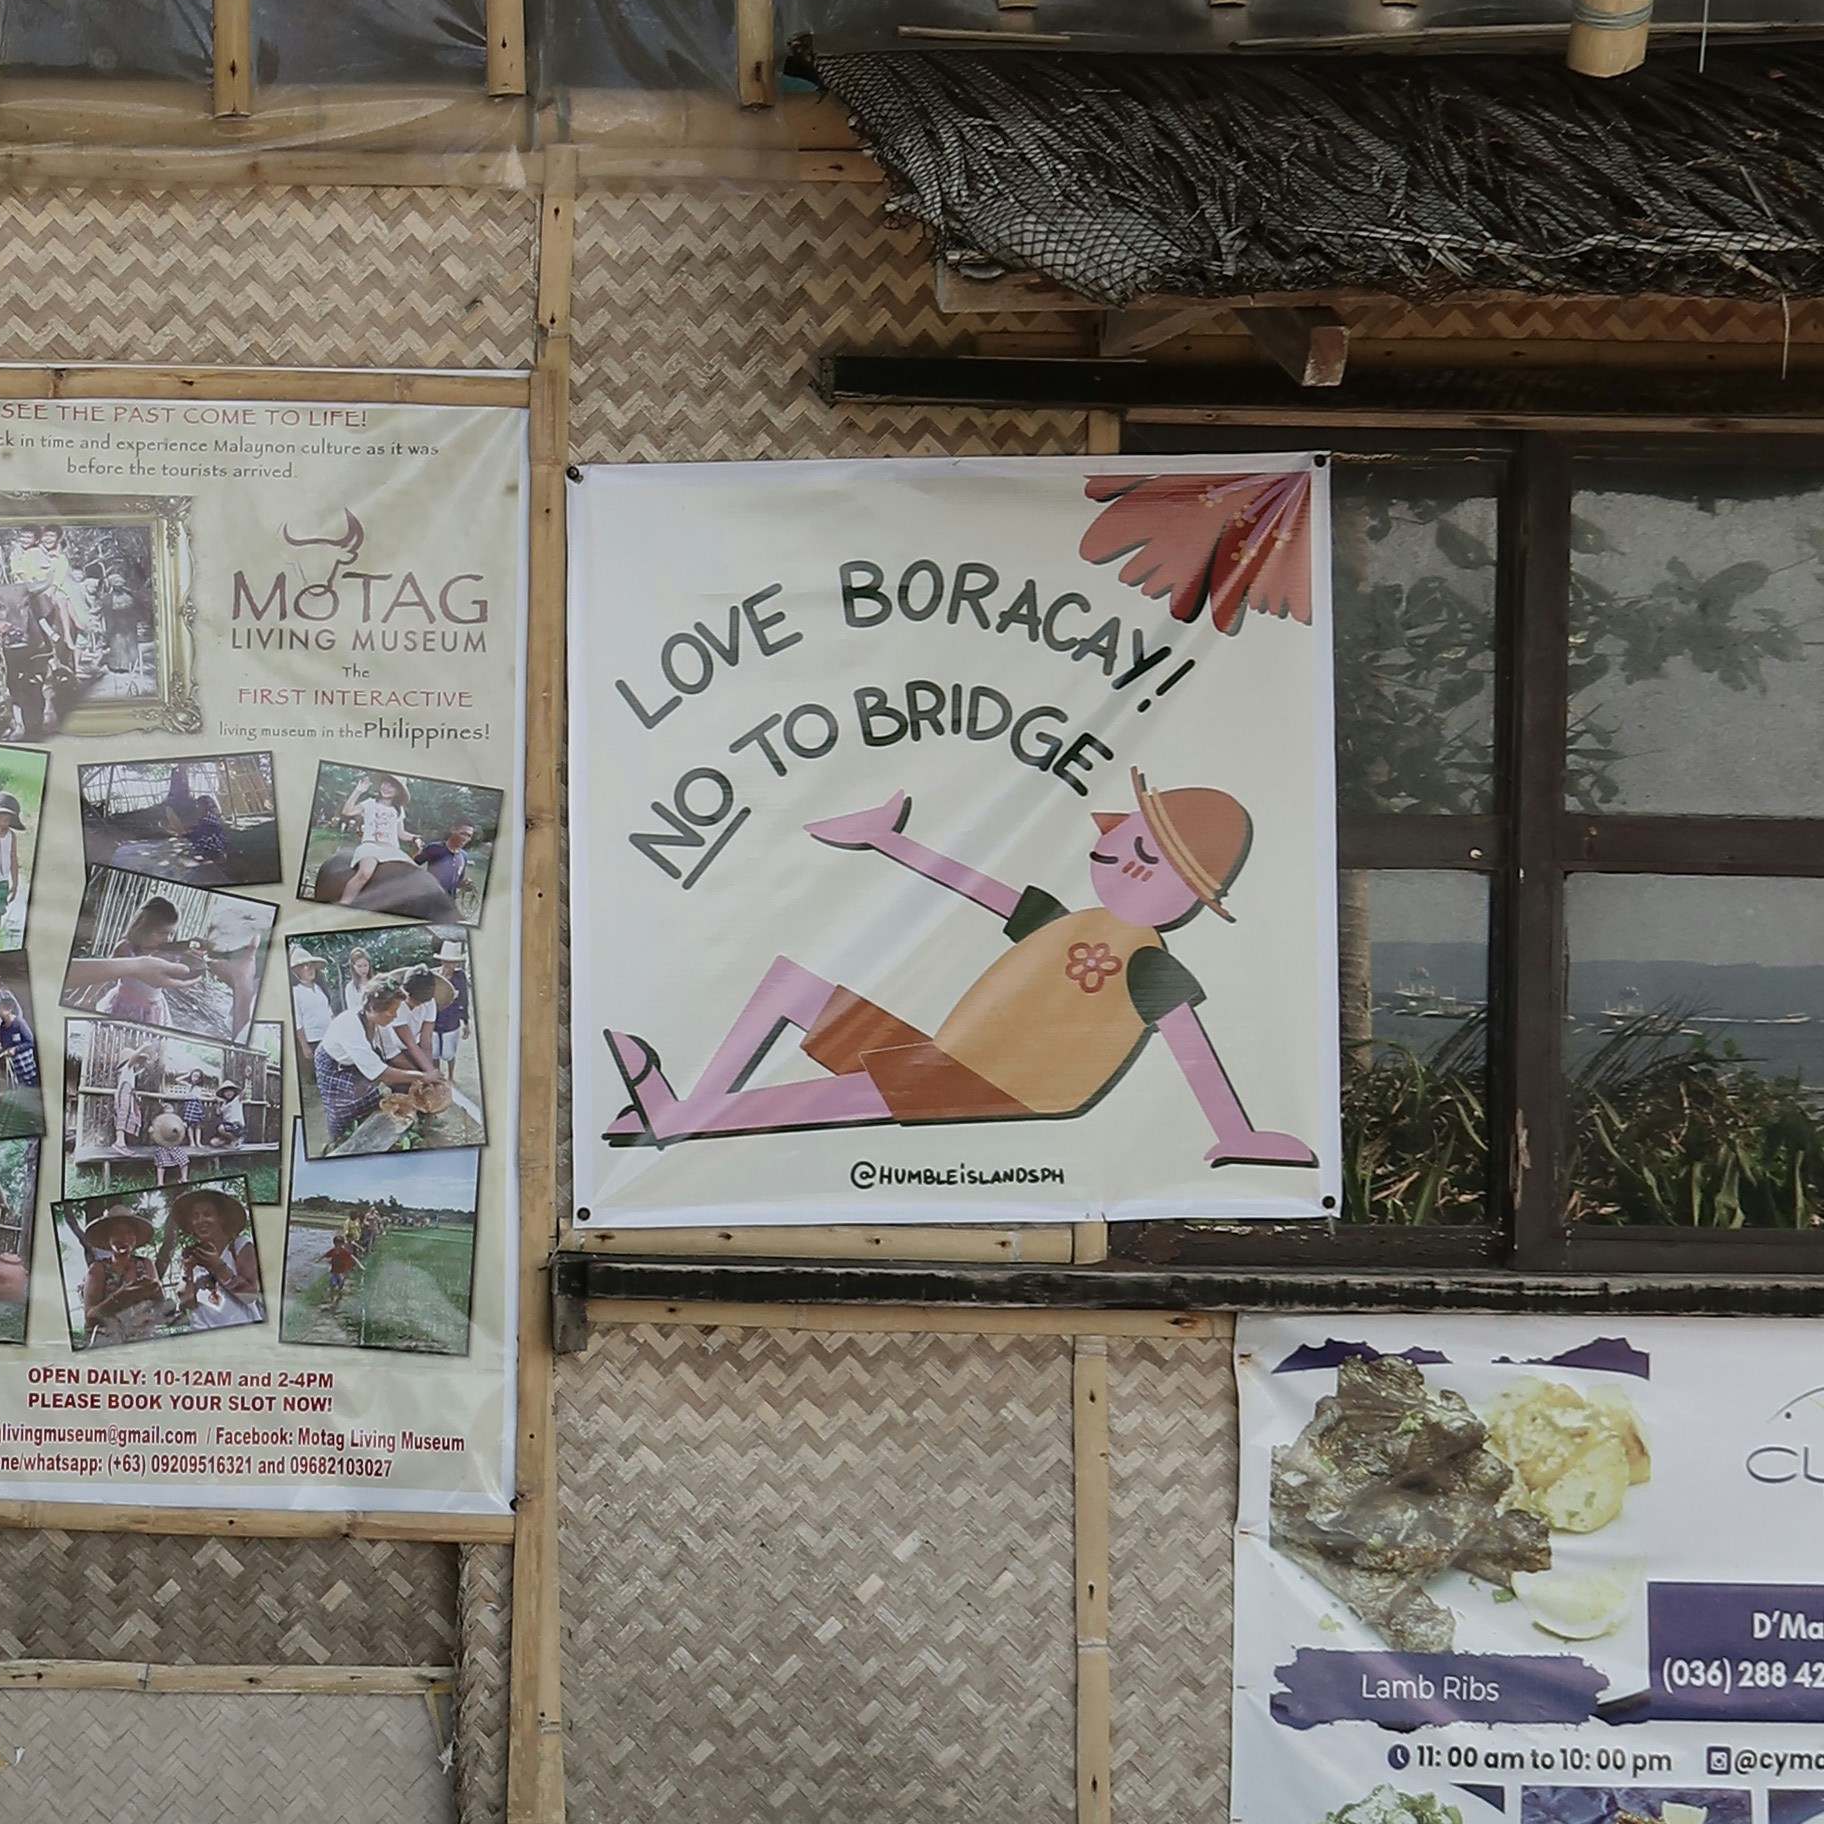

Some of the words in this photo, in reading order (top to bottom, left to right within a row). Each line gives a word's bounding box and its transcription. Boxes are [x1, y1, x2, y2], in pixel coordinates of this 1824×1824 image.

[1, 403, 48, 420] SEE
[56, 405, 105, 422] THE
[114, 407, 175, 424] PAST
[183, 408, 256, 425] COME
[265, 409, 300, 426] TO
[309, 410, 367, 427] LIFE!
[20, 433, 35, 448] in
[41, 434, 74, 449] time
[80, 434, 111, 450] and
[116, 437, 208, 458] experience
[214, 436, 296, 459] Malaynon
[301, 438, 361, 455] culture
[366, 445, 385, 456] as
[391, 441, 403, 455] it
[407, 445, 439, 456] was
[67, 457, 124, 475] before
[129, 458, 157, 476] the
[161, 462, 228, 477] tourists
[231, 628, 336, 651] LIVING
[351, 629, 487, 653] MUSEUM
[614, 582, 804, 730] LOVE
[838, 558, 1196, 715] BORACAY!
[342, 663, 370, 678] The
[238, 688, 306, 706] FIRST
[313, 689, 474, 708] INTERACTIVE
[219, 721, 257, 741] living
[261, 728, 317, 738] museum
[321, 724, 334, 738] in
[339, 725, 363, 739] the
[364, 717, 490, 748] Philippines!
[627, 765, 738, 884] NO
[729, 701, 840, 776] TO
[854, 678, 1115, 797] BRIDGE
[28, 1368, 80, 1385] OPEN
[87, 1369, 147, 1386] DAILY:
[153, 1370, 232, 1387] 10-12AM
[238, 1372, 272, 1387] and
[278, 1372, 334, 1389] 2-4PM
[28, 1393, 101, 1409] PLEASE
[107, 1394, 163, 1410] BOOK
[169, 1395, 222, 1411] YOUR
[228, 1396, 277, 1412] SLOT
[283, 1396, 333, 1412] NOW!
[215, 1426, 294, 1446] Facebook:
[298, 1427, 345, 1450] Motag
[350, 1429, 396, 1453] Living
[401, 1431, 465, 1452] Museum
[107, 1453, 146, 1477] (+63)
[151, 1455, 252, 1474] 09209516321
[258, 1457, 285, 1475] and
[290, 1456, 393, 1477] 09682103027
[1361, 1673, 1435, 1701] Lamb
[1442, 1676, 1500, 1702] Ribs
[1662, 1656, 1732, 1694] (036)
[1738, 1659, 1787, 1689] 288
[1447, 1746, 1476, 1768] 00
[1484, 1751, 1525, 1770] am
[1531, 1748, 1554, 1770] to
[1597, 1748, 1627, 1771] 00
[1632, 1752, 1672, 1777] pm
